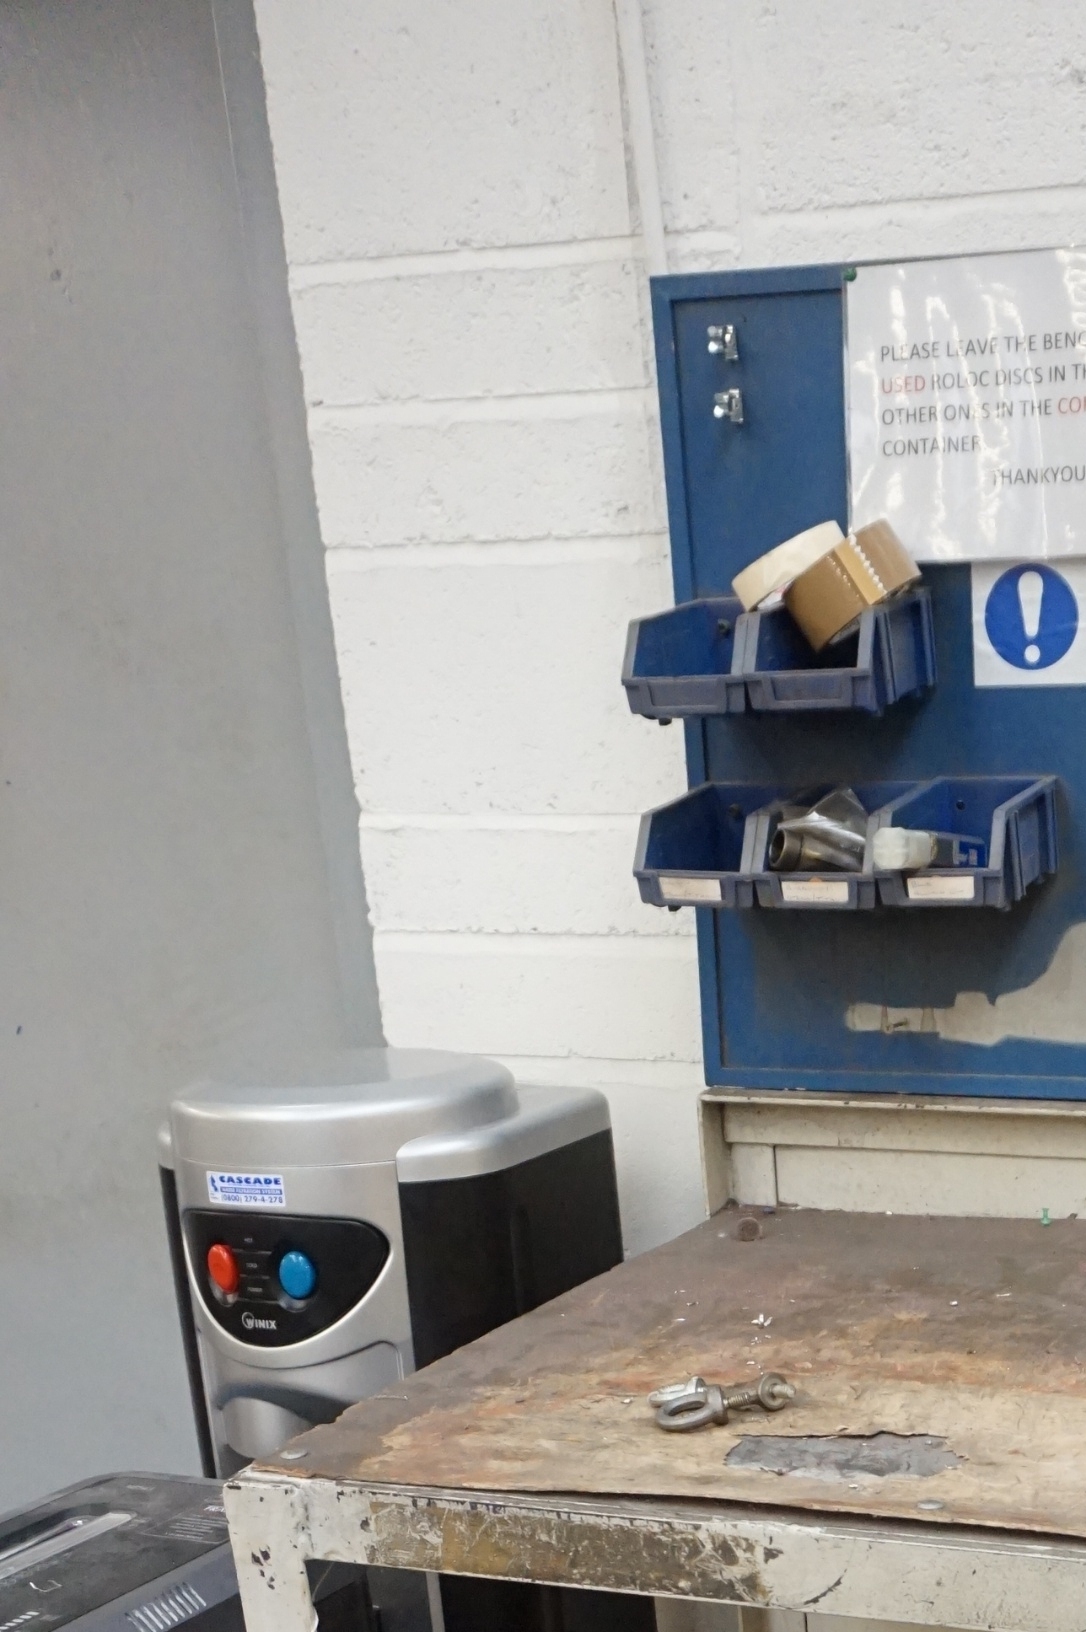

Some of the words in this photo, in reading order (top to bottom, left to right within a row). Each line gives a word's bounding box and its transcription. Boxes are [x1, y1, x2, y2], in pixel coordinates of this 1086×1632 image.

[881, 341, 941, 362] PLEASE
[1003, 334, 1038, 353] THE
[882, 375, 926, 394] USED
[931, 370, 989, 391] ROLOC
[995, 366, 1043, 387] DISCS
[1049, 365, 1066, 382] IN
[882, 405, 937, 425] OTHER
[996, 400, 1013, 418] IN
[1019, 398, 1052, 417] THE
[992, 465, 1086, 486] THANKYOU
[219, 1175, 282, 1185] CASCADE
[245, 1318, 277, 1330] WINIX
